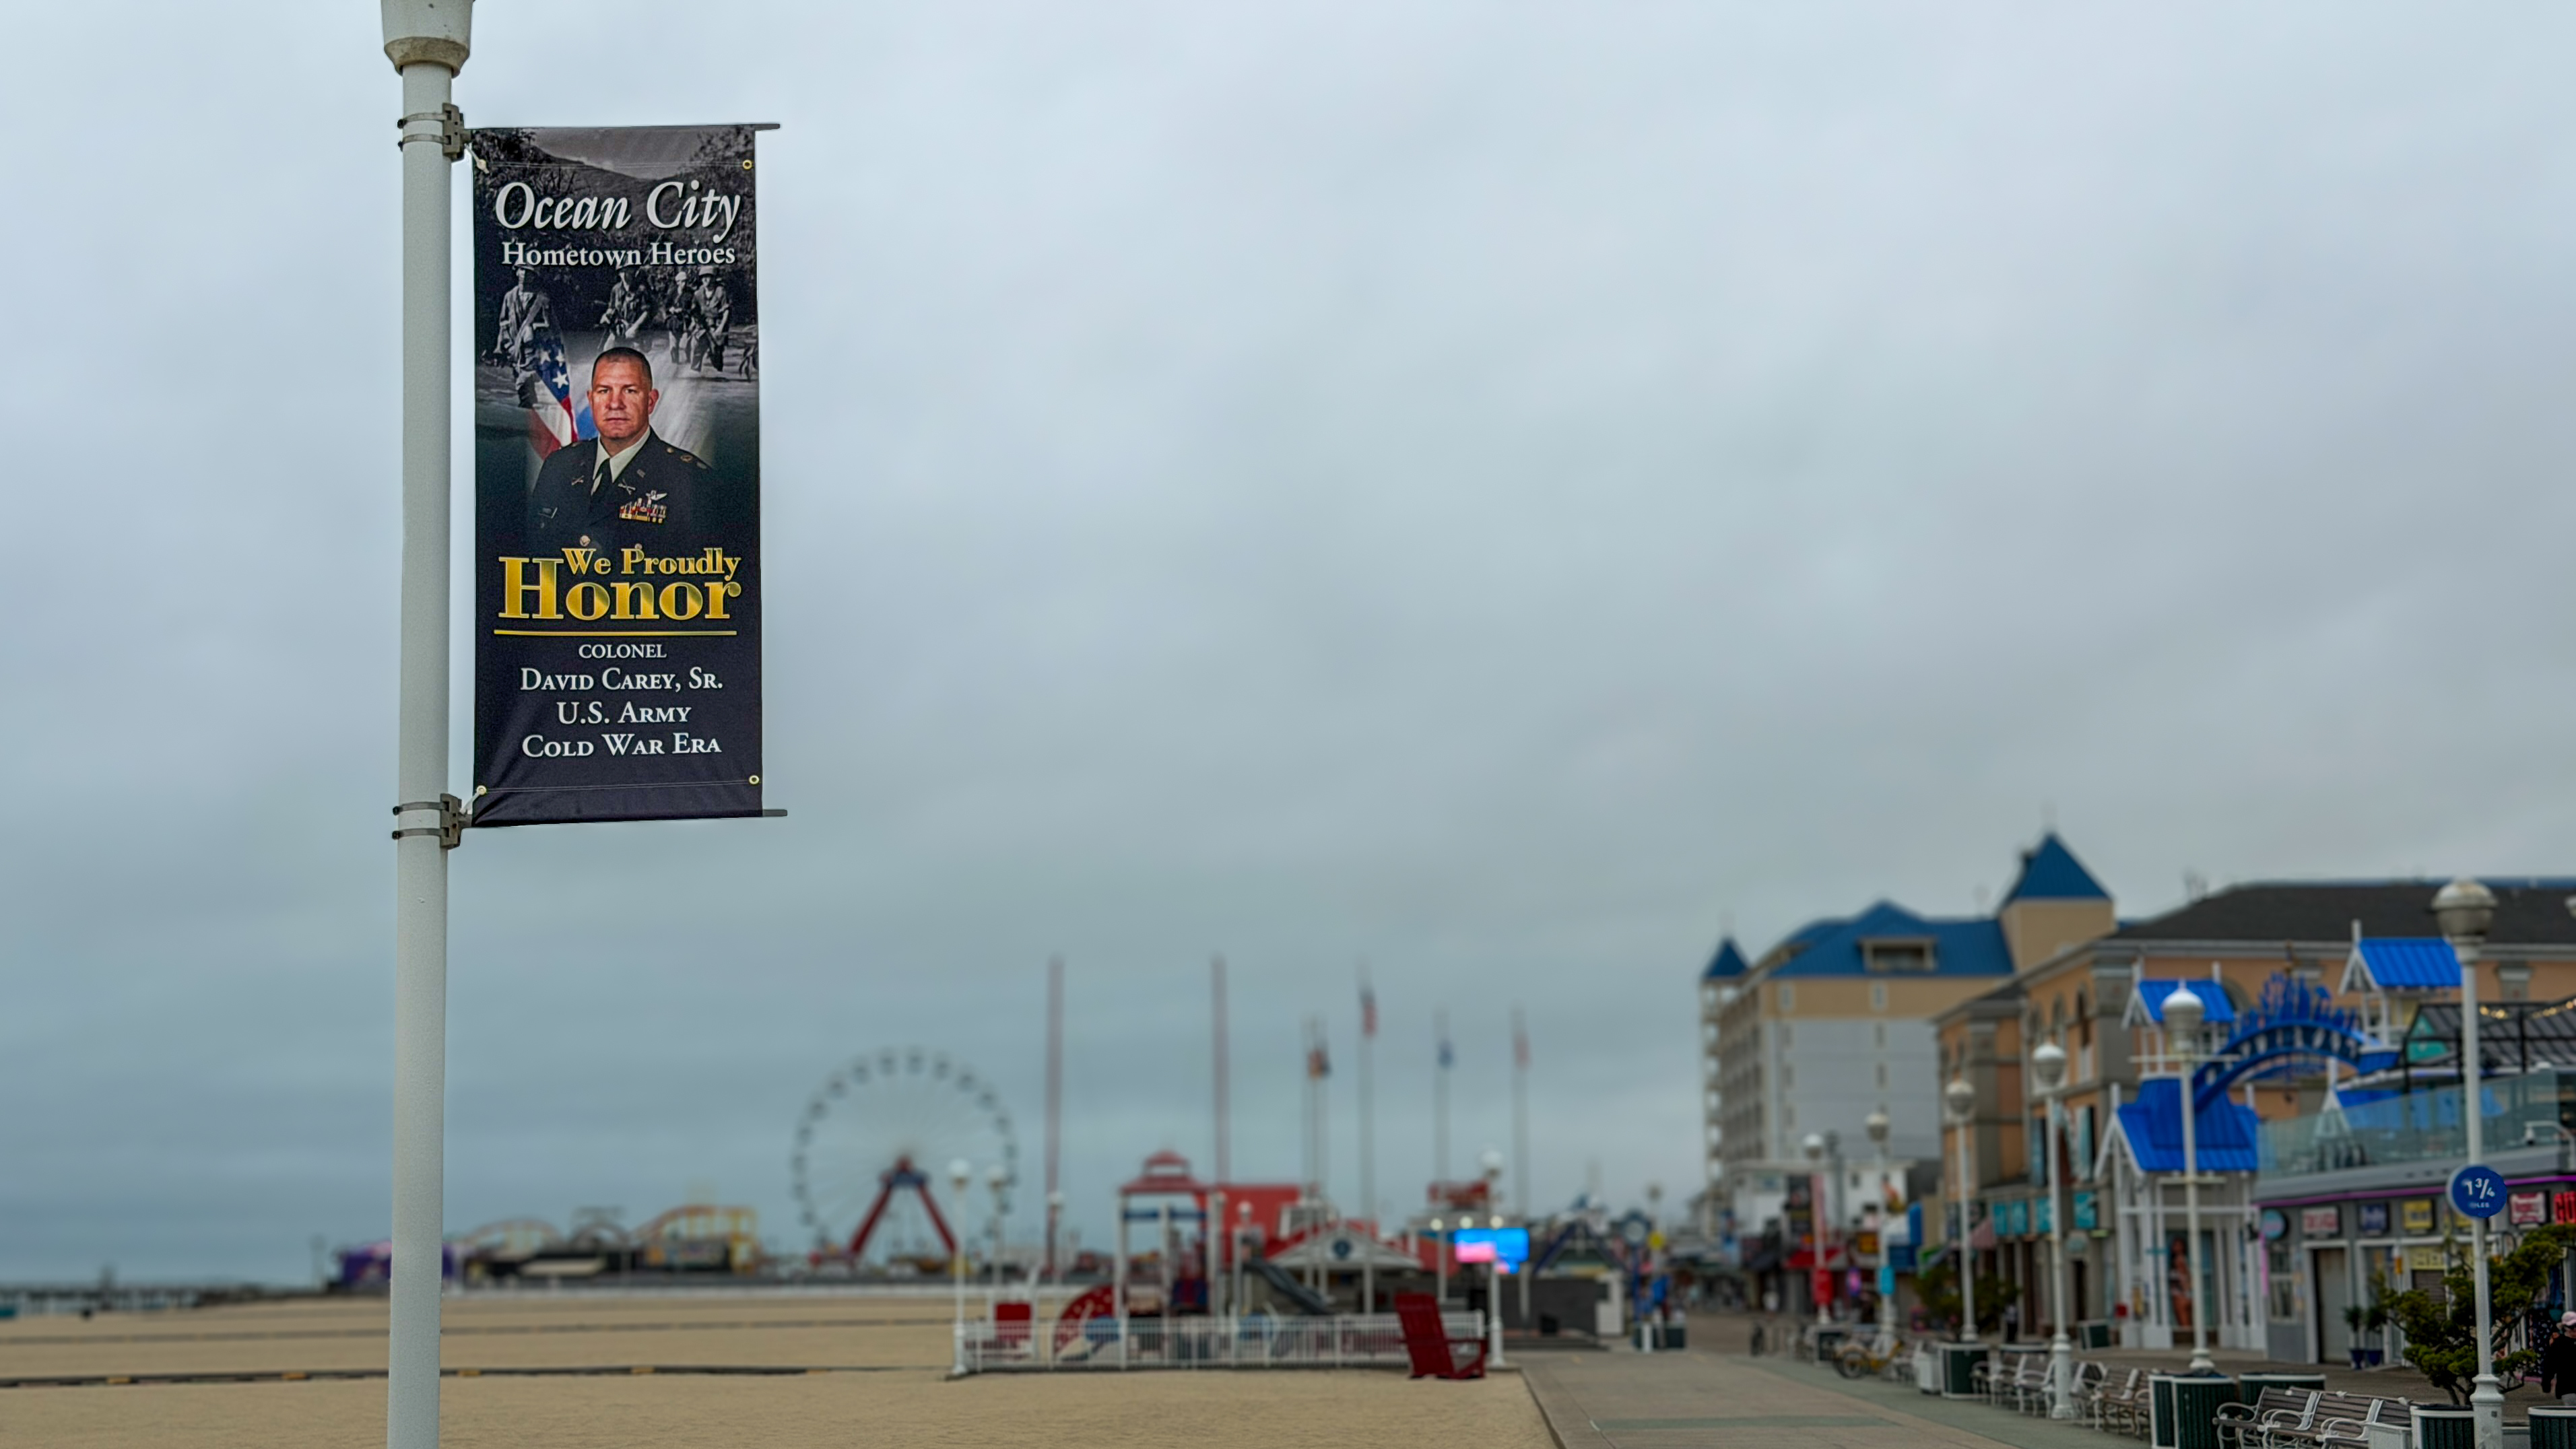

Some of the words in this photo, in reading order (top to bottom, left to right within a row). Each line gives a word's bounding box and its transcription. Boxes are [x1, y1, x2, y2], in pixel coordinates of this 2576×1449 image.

[495, 181, 632, 230] Ocean
[647, 180, 741, 244] City
[502, 241, 642, 267] Hometown
[650, 242, 735, 265] Heroes
[562, 547, 612, 576] We
[621, 547, 741, 580] Proudly
[498, 557, 741, 620] Honor
[579, 644, 667, 659] COLONEL
[556, 701, 609, 725] U.S.
